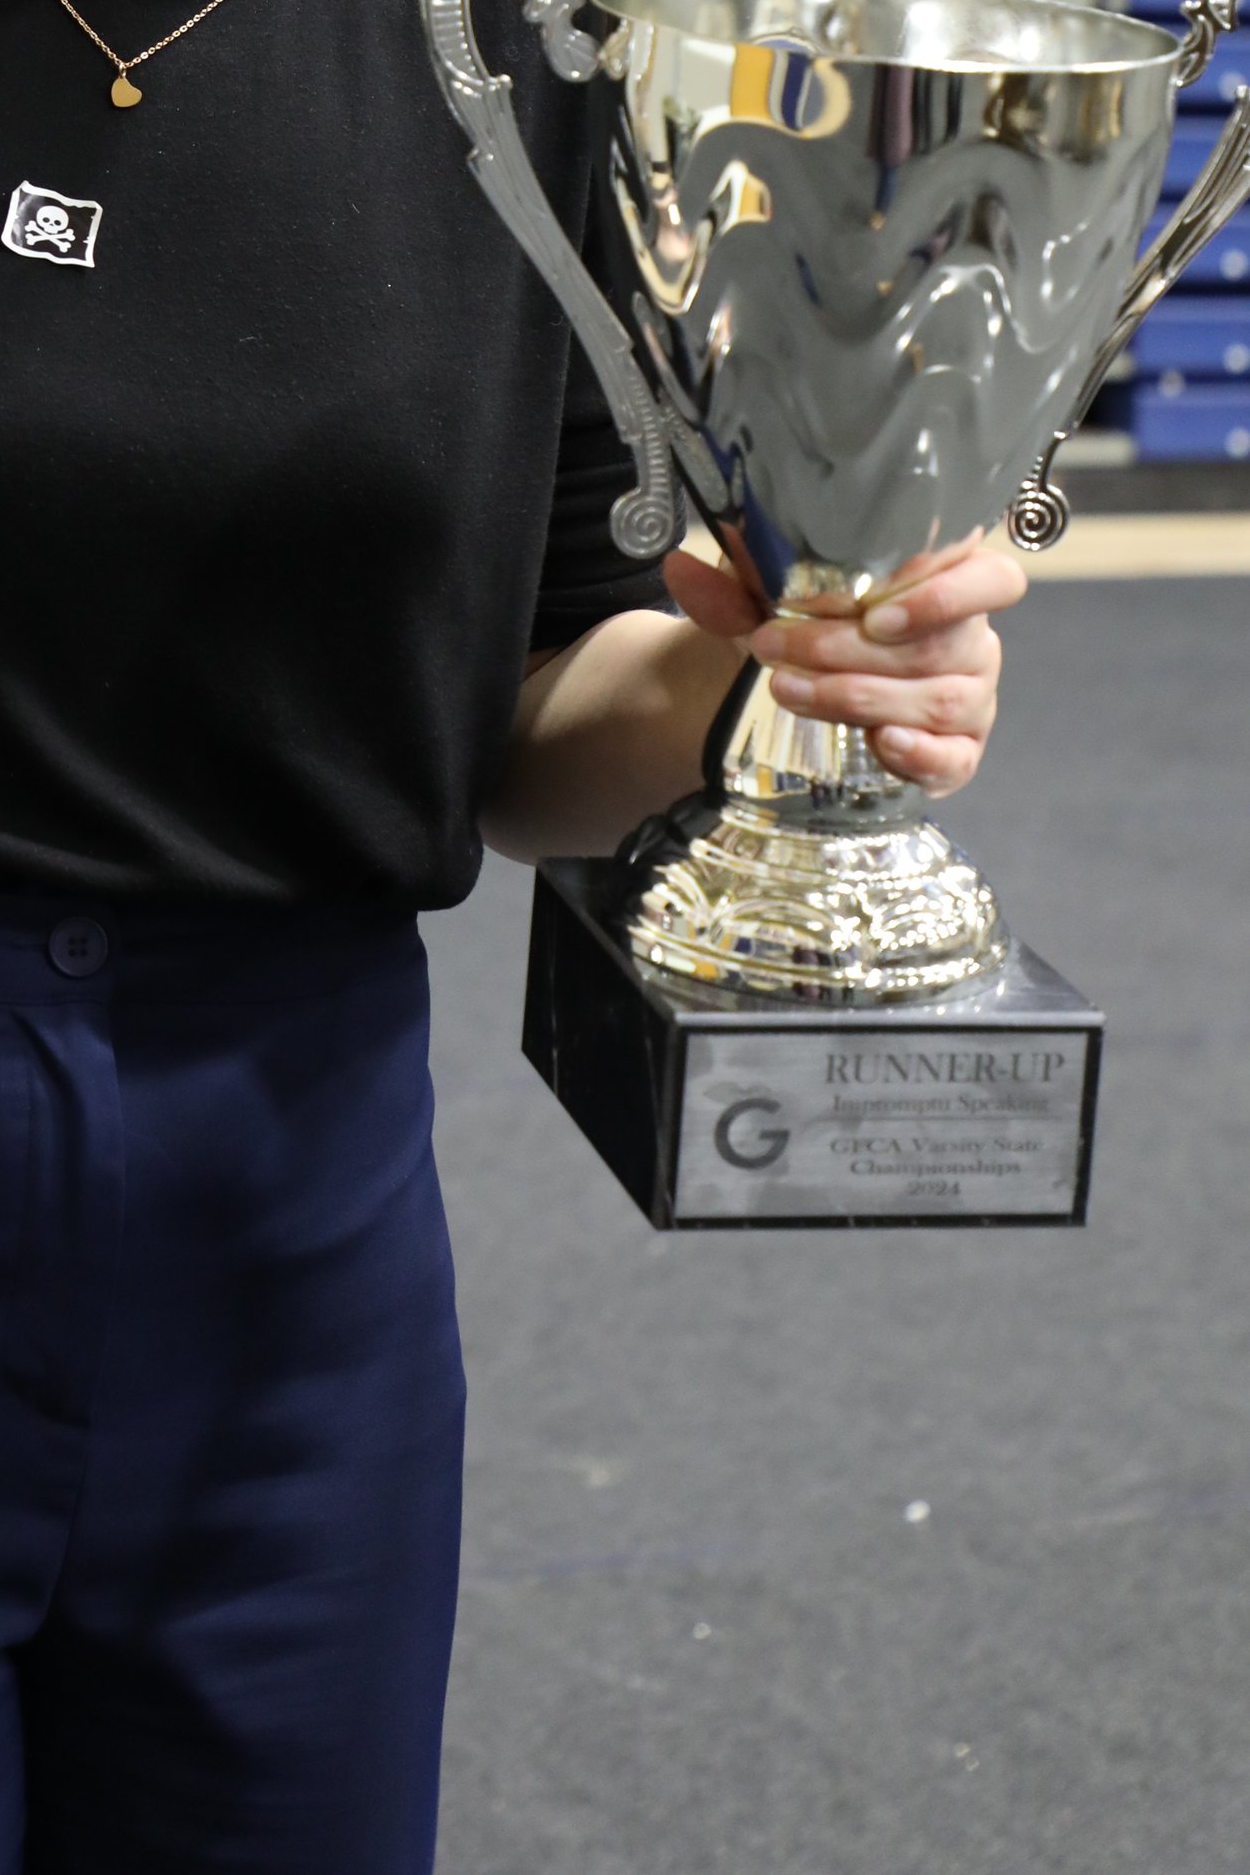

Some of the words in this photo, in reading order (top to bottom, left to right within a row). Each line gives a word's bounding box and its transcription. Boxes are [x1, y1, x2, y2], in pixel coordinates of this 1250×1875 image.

[825, 1052, 1066, 1085] RUNNER-UP
[958, 1093, 1050, 1115] Speaking
[713, 1096, 792, 1171] G
[911, 1136, 985, 1156] Varsity
[992, 1136, 1044, 1153] State
[850, 1158, 1022, 1177] Championships
[906, 1180, 961, 1197] 2024
